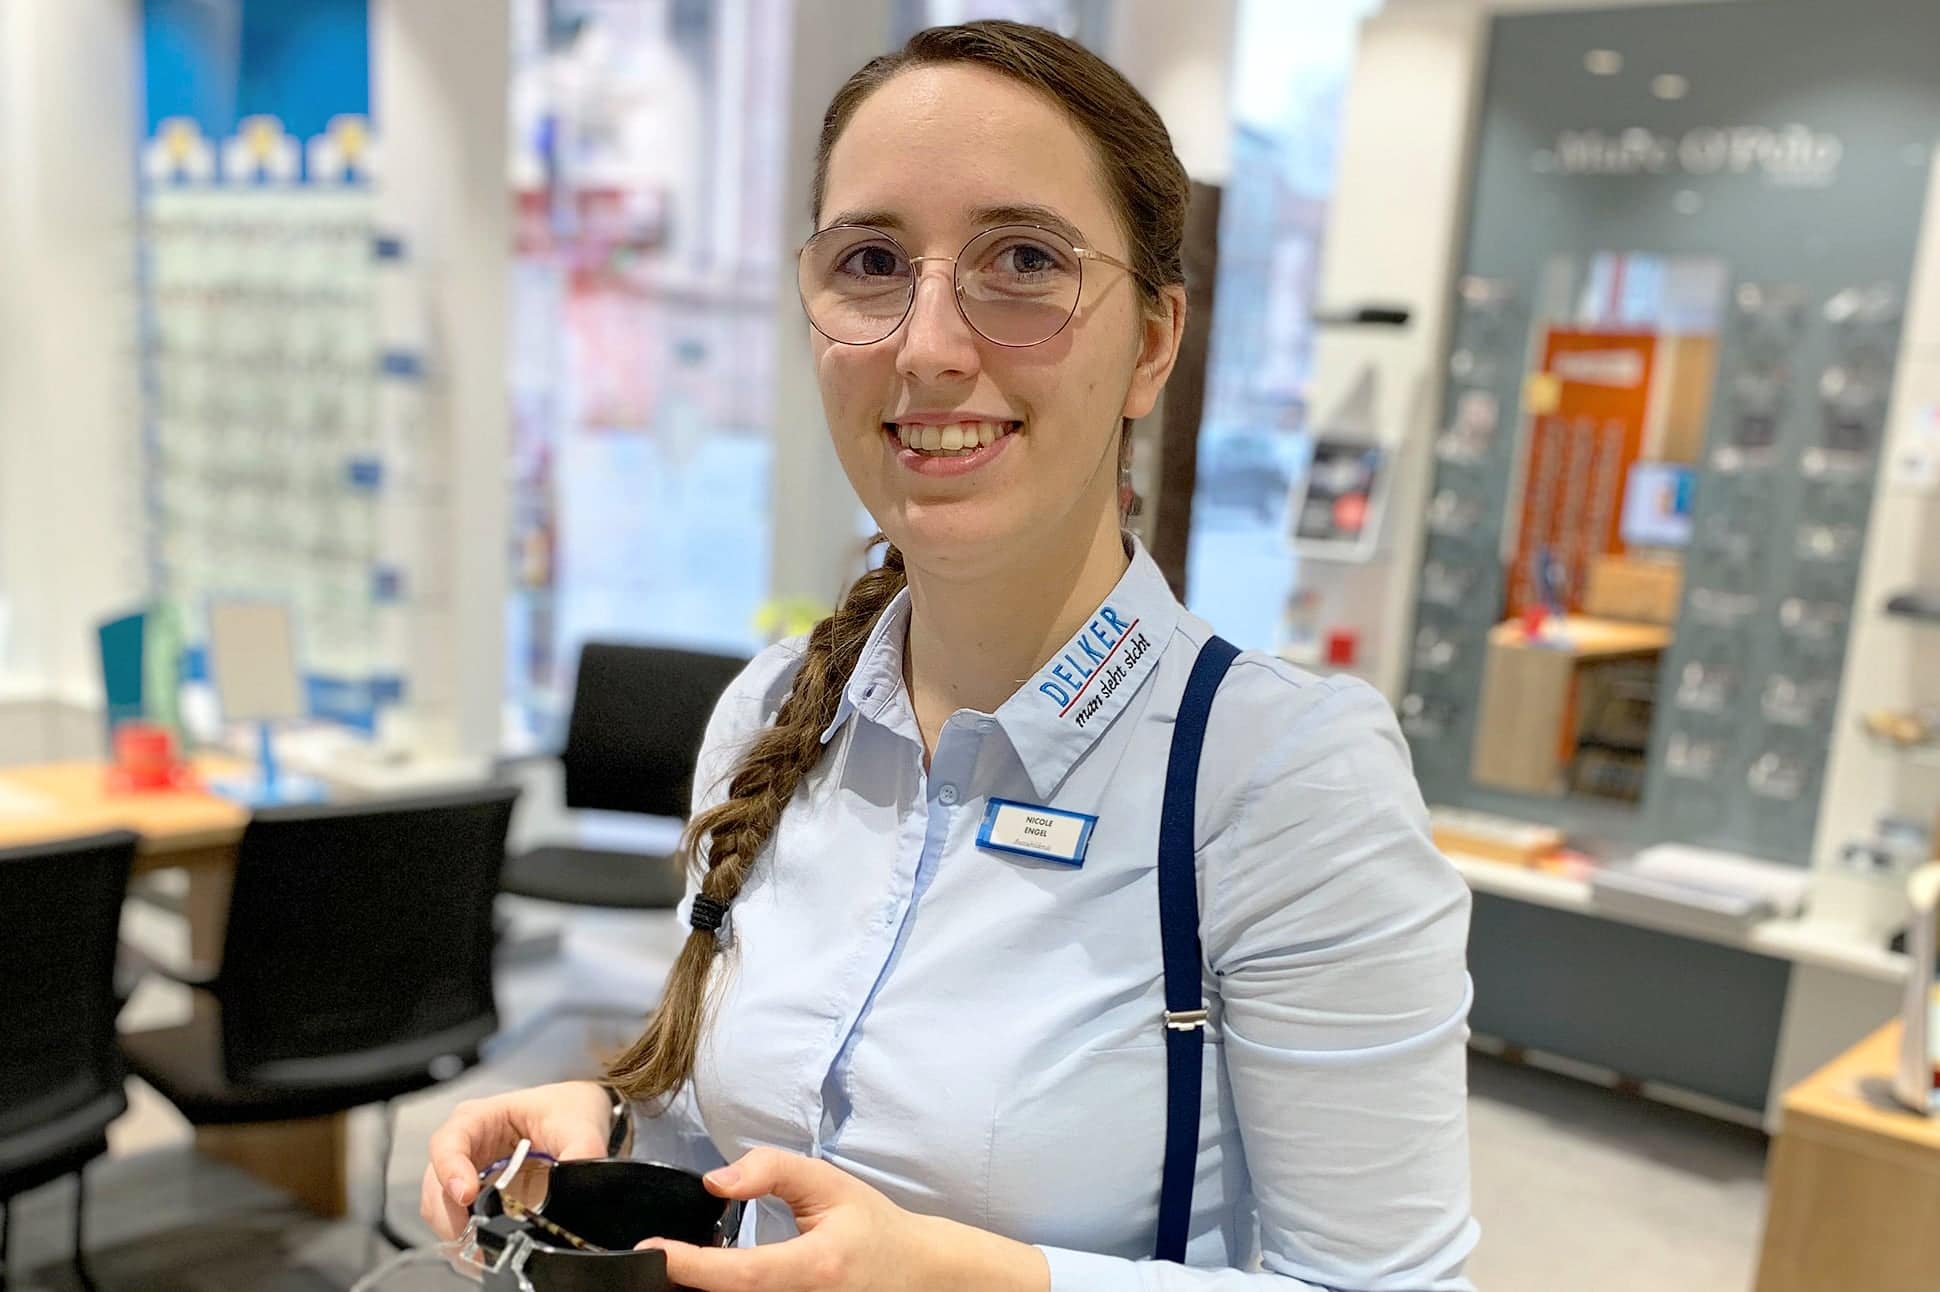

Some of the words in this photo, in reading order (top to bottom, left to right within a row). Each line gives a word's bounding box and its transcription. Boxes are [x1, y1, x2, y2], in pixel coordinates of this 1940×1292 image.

[1039, 606, 1130, 708] DELKER
[1075, 695, 1103, 728] man
[1024, 826, 1047, 837] ENGEL
[1025, 816, 1054, 827] NICOLE
